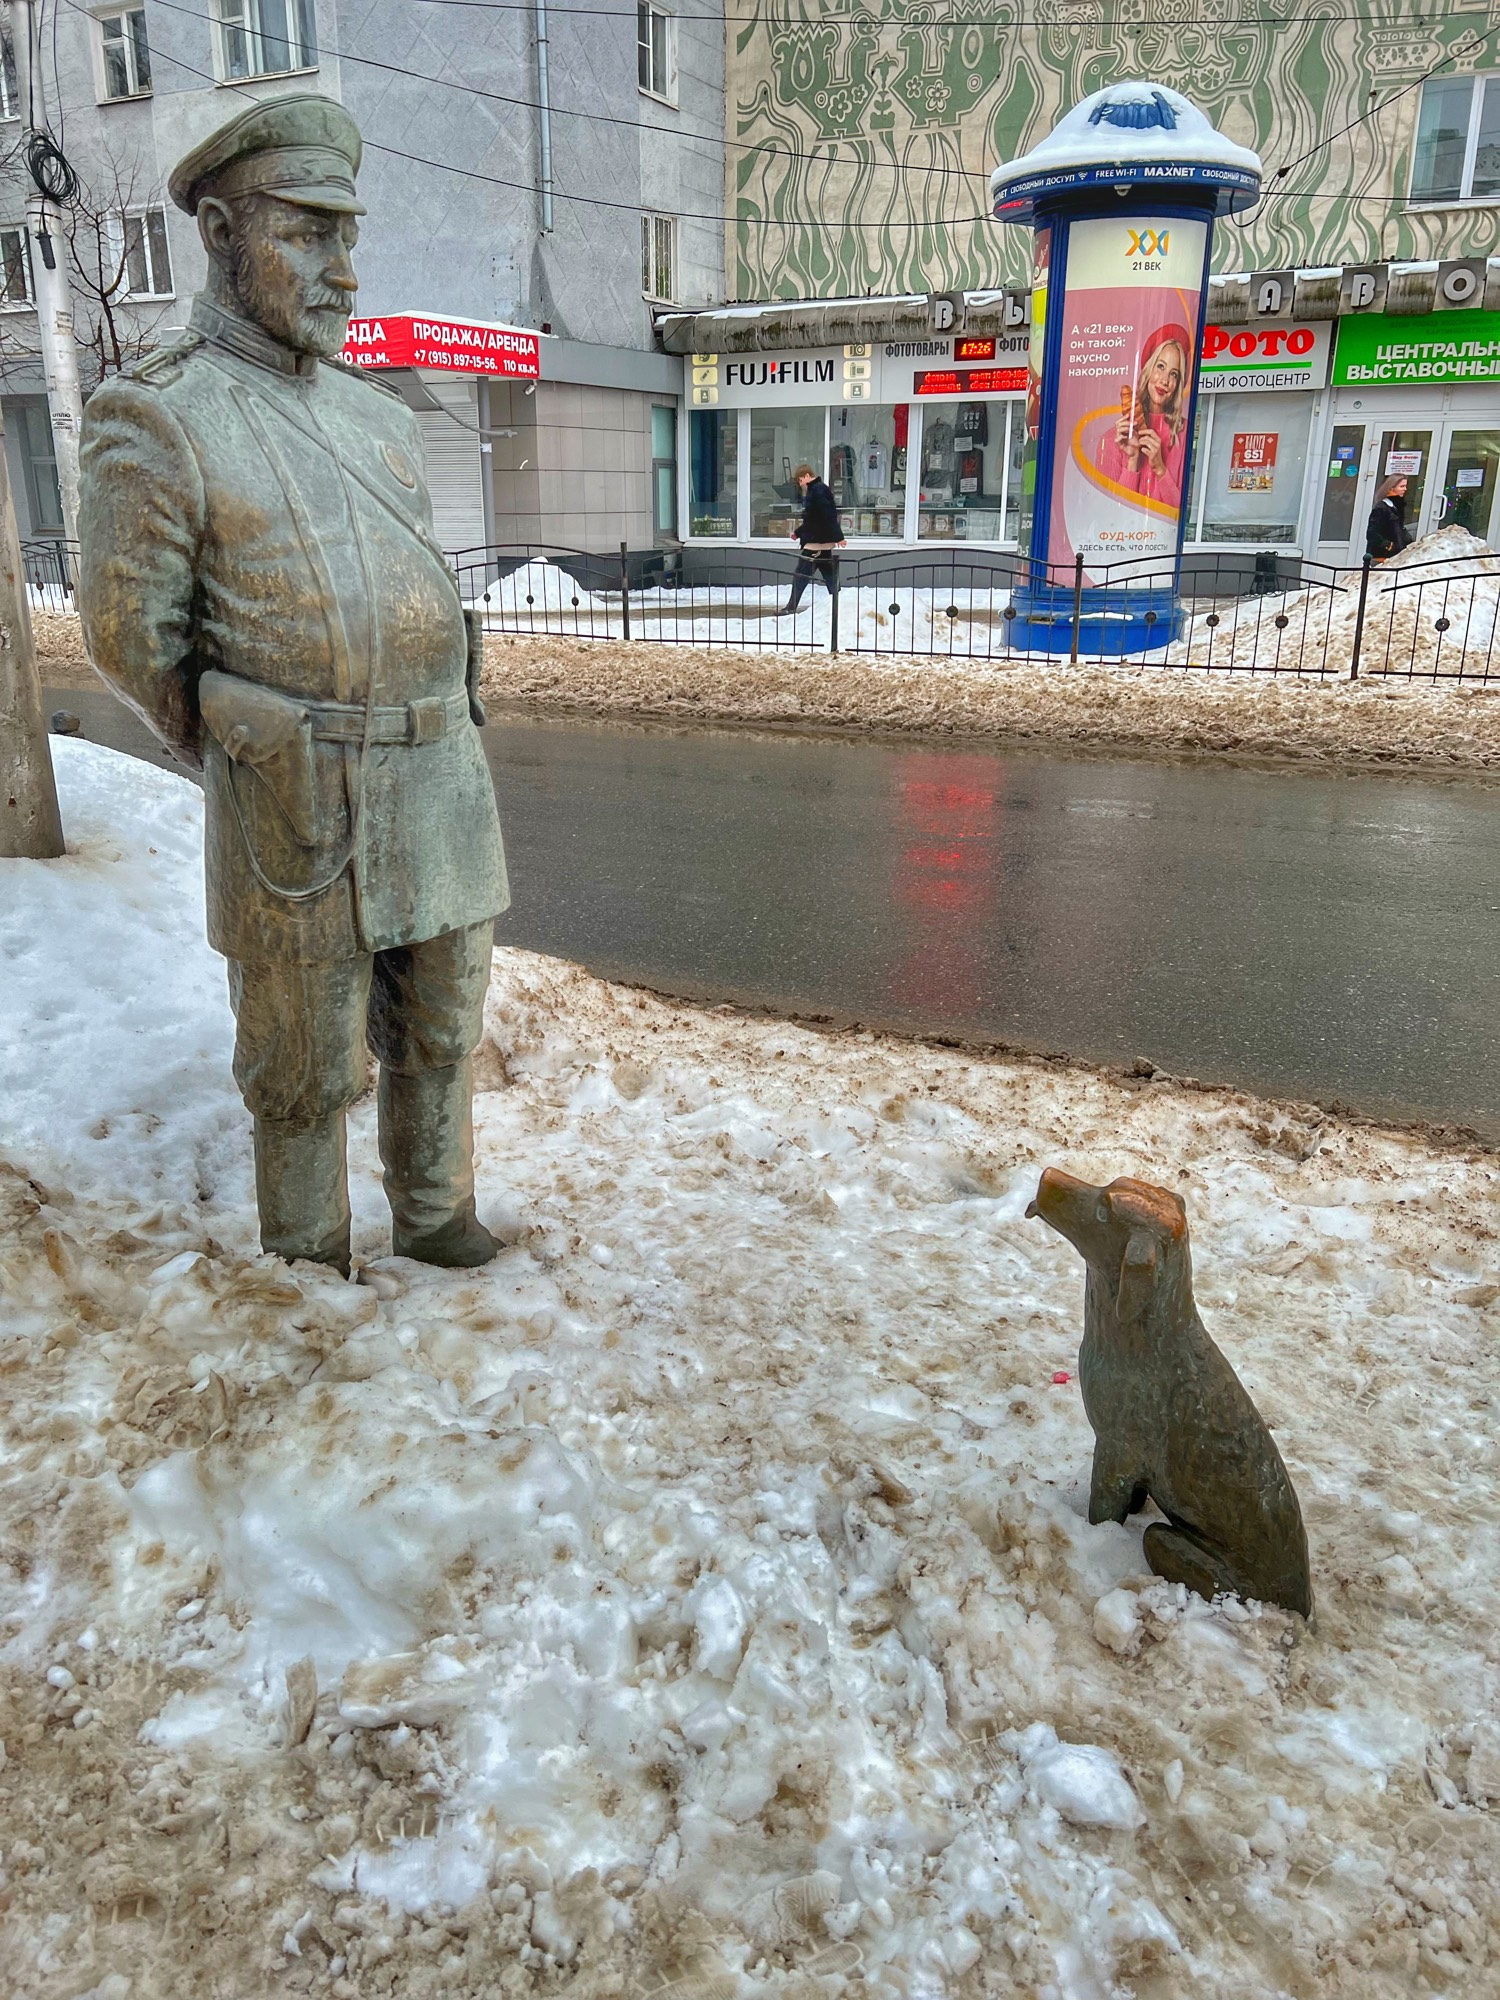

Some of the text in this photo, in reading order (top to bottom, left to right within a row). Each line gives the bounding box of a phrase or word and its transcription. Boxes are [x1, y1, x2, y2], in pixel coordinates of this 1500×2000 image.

[1095, 168, 1137, 178] FREE WI-FI
[1144, 167, 1195, 177] MAXNET
[1202, 169, 1240, 181] СВОБОДНЫЙ
[1010, 174, 1075, 194] СВОБОДНЫЙ ДОСТУП
[1132, 261, 1161, 271] 21 ВЕК
[345, 321, 387, 346] НДА
[1071, 323, 1134, 335] А «21 век»
[413, 322, 536, 355] ПРОДАЖА/АРЕНДА
[999, 337, 1030, 352] ФОТО
[1070, 336, 1126, 349] он такой:
[885, 340, 949, 358] ФОТОТОВАРЫ
[960, 342, 992, 356] 17:26
[1376, 341, 1500, 363] ЦЕНТРАЛЬН
[414, 350, 426, 362] +7
[428, 351, 452, 366] (915)
[453, 354, 498, 370] 897-15-56.
[503, 360, 516, 371] 110
[1069, 352, 1111, 365] вкусно
[726, 360, 834, 386] FUJIFILM
[1068, 365, 1129, 378] накормит!
[1346, 360, 1500, 380] ВЫСТАВОЧНЫ
[1198, 373, 1311, 389] НЫЙ ФОТОЦЕНТР
[1244, 449, 1263, 459] 651
[1099, 530, 1157, 542] ФУД-КОРТ:
[1078, 544, 1104, 552] ЗДЕСЬ
[1105, 544, 1127, 553] ЕСТЬ,
[1129, 544, 1143, 552] ЧТО
